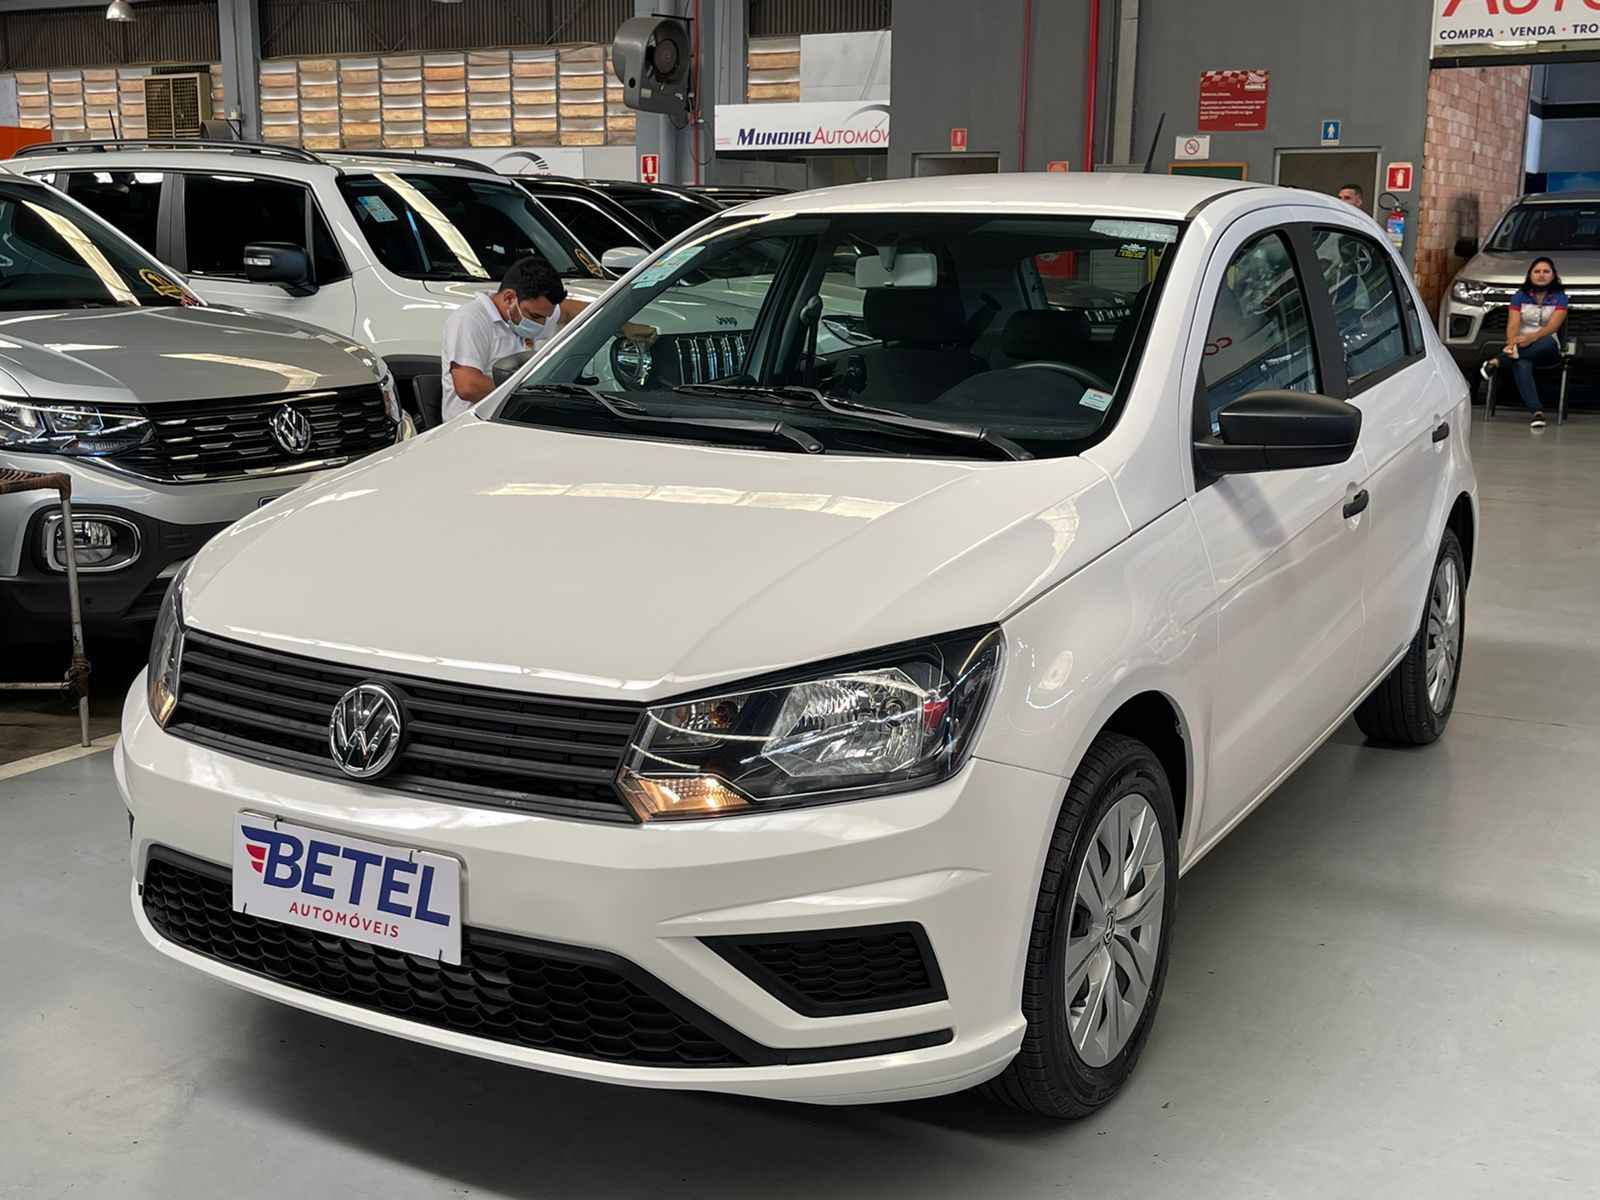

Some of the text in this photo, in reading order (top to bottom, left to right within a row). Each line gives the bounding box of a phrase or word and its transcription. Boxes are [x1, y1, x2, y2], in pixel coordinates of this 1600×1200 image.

[1439, 23, 1599, 40] COMPRA VENDA TRO
[737, 128, 813, 146] MUNDIAL
[241, 825, 451, 927] BETEL
[289, 901, 400, 938] AUTOMÓVEIS
